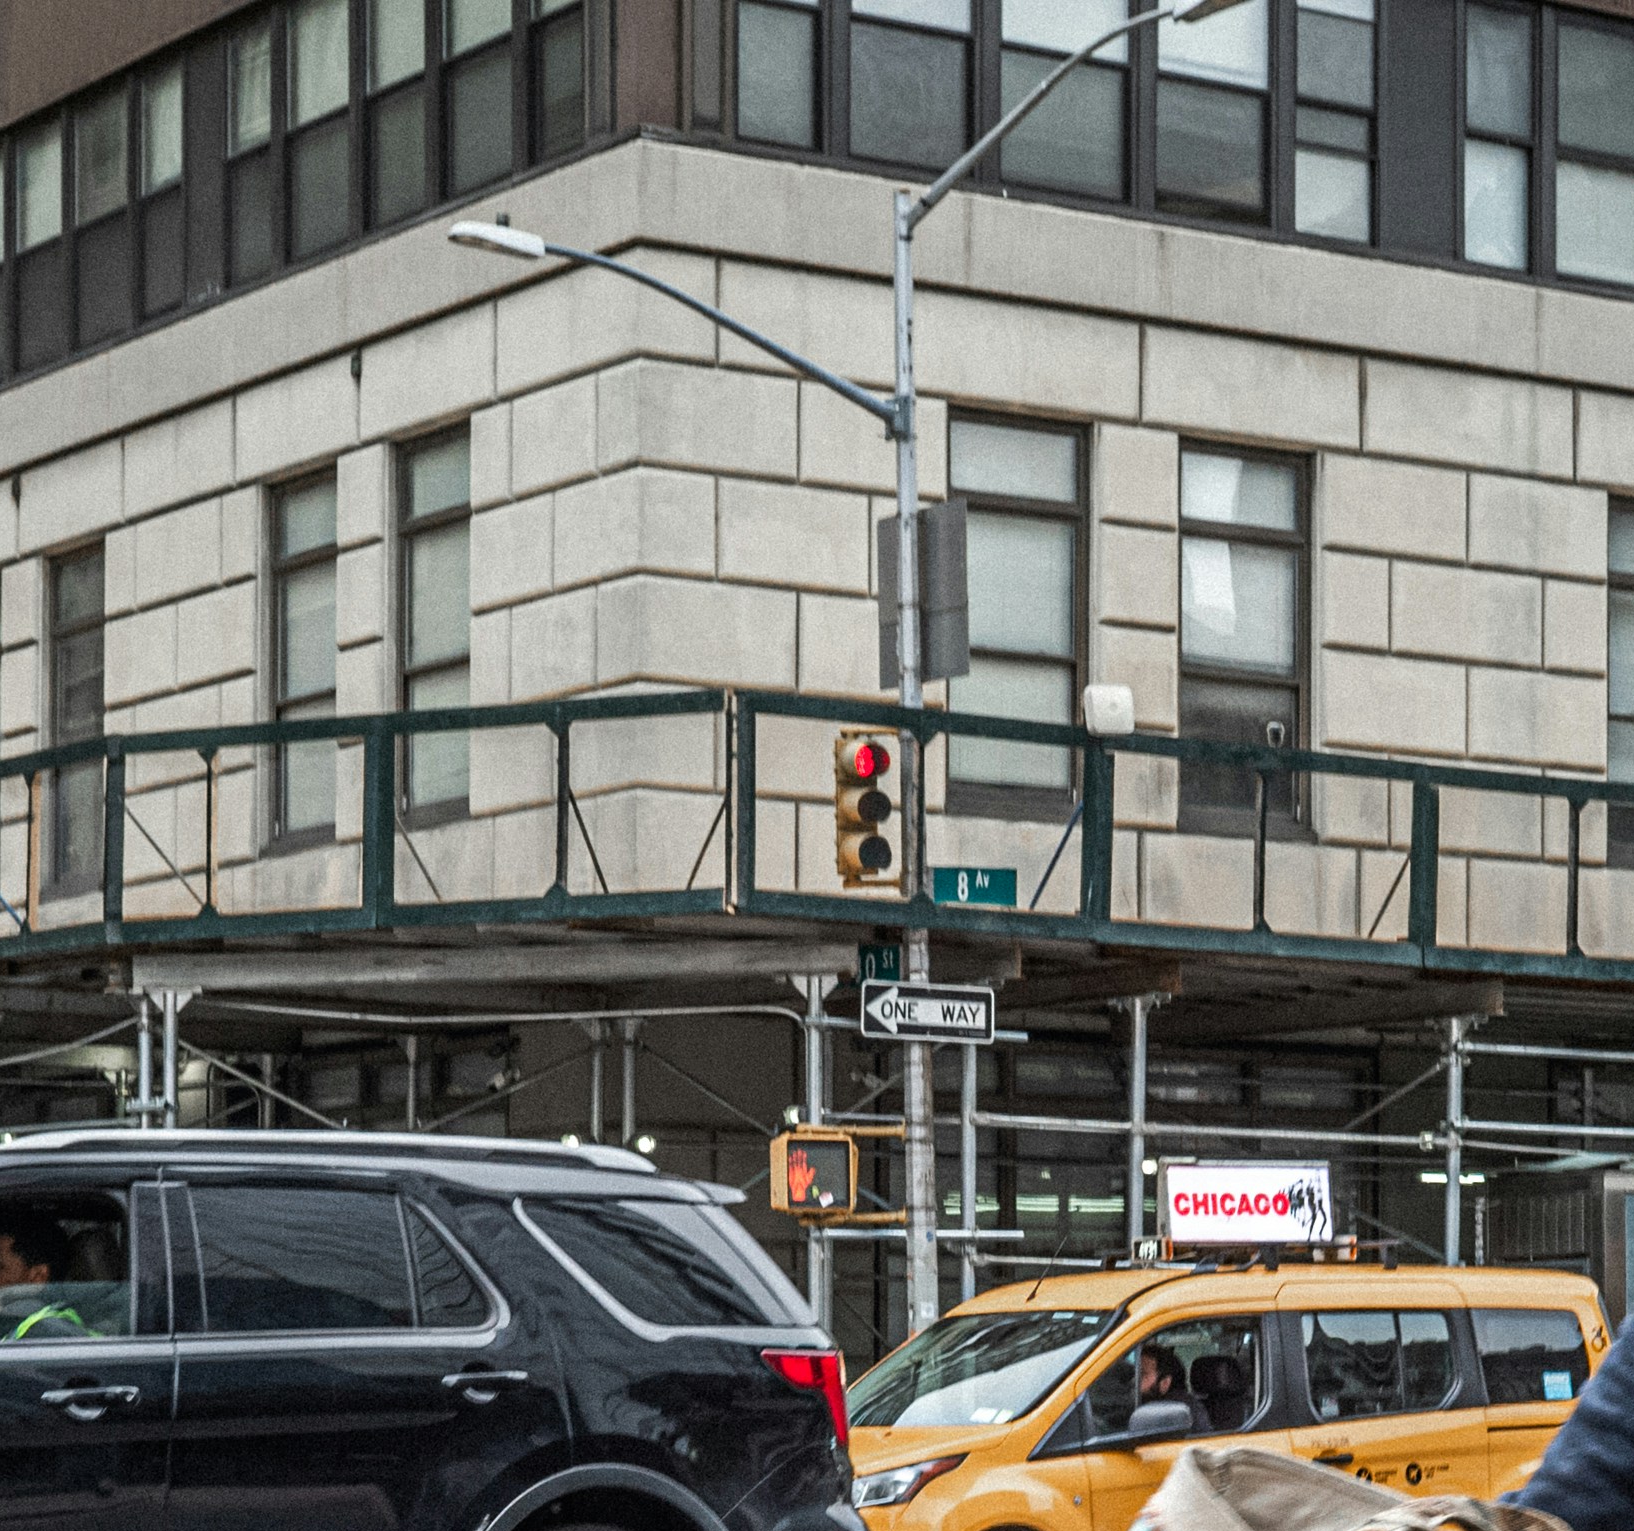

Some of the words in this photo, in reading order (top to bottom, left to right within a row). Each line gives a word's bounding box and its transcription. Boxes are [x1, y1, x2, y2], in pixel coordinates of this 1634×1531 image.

[957, 870, 969, 902] 8
[975, 869, 990, 889] Av
[882, 948, 894, 969] St
[880, 1000, 918, 1020] ONE
[941, 1002, 980, 1023] WAY
[1173, 1192, 1290, 1216] CHICAGO
